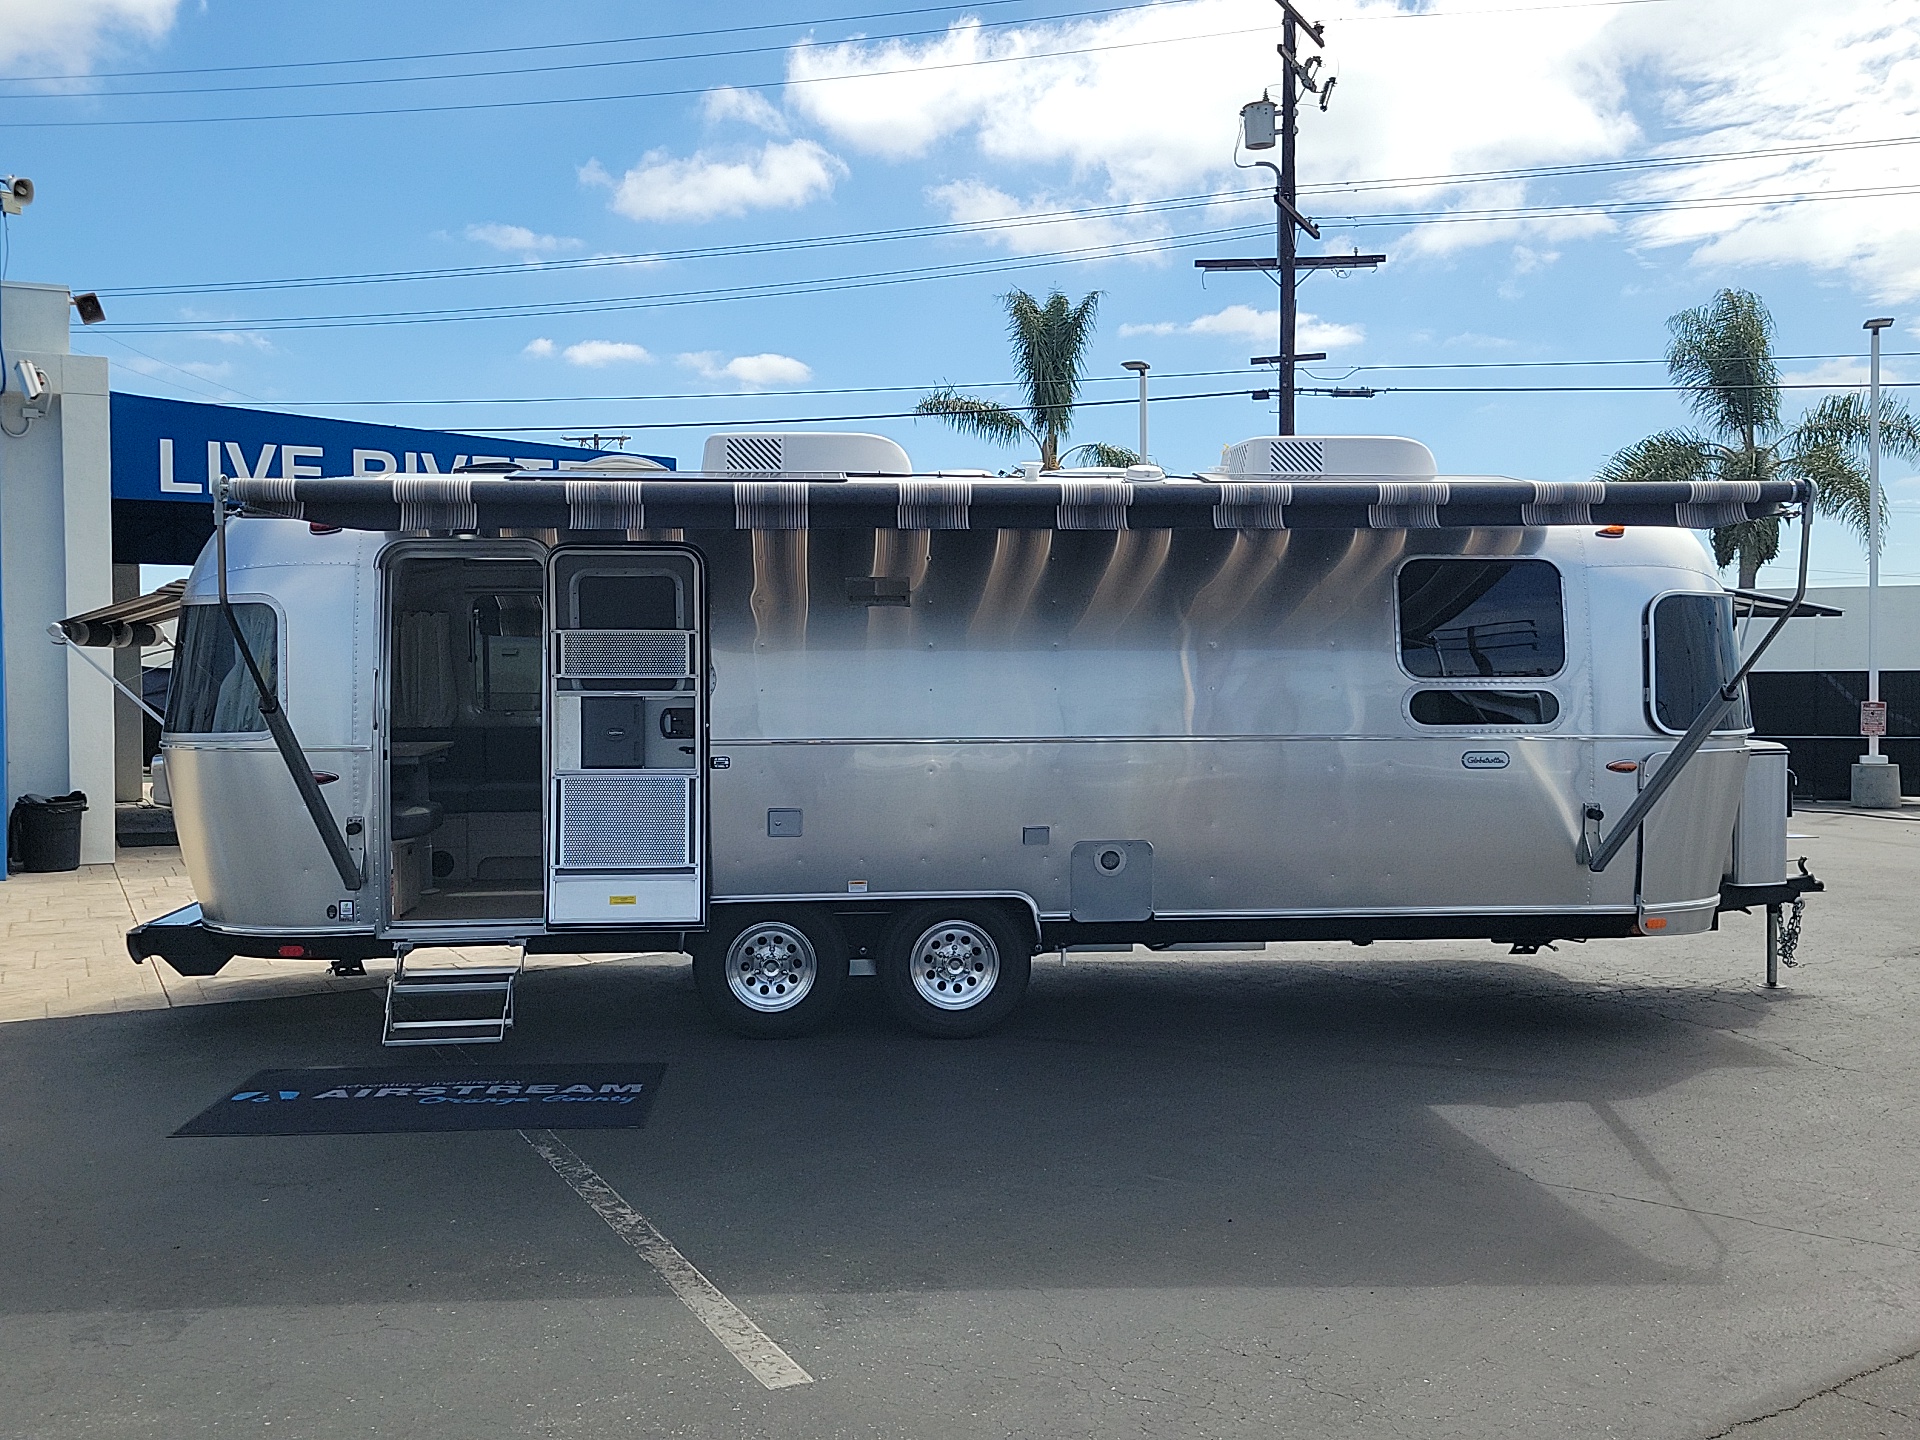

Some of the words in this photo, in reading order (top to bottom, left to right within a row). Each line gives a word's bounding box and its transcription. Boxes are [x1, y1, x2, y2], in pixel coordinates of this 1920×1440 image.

[159, 438, 324, 494] LIVE
[312, 1083, 643, 1101] AIRSTREAM
[541, 1094, 637, 1105] County
